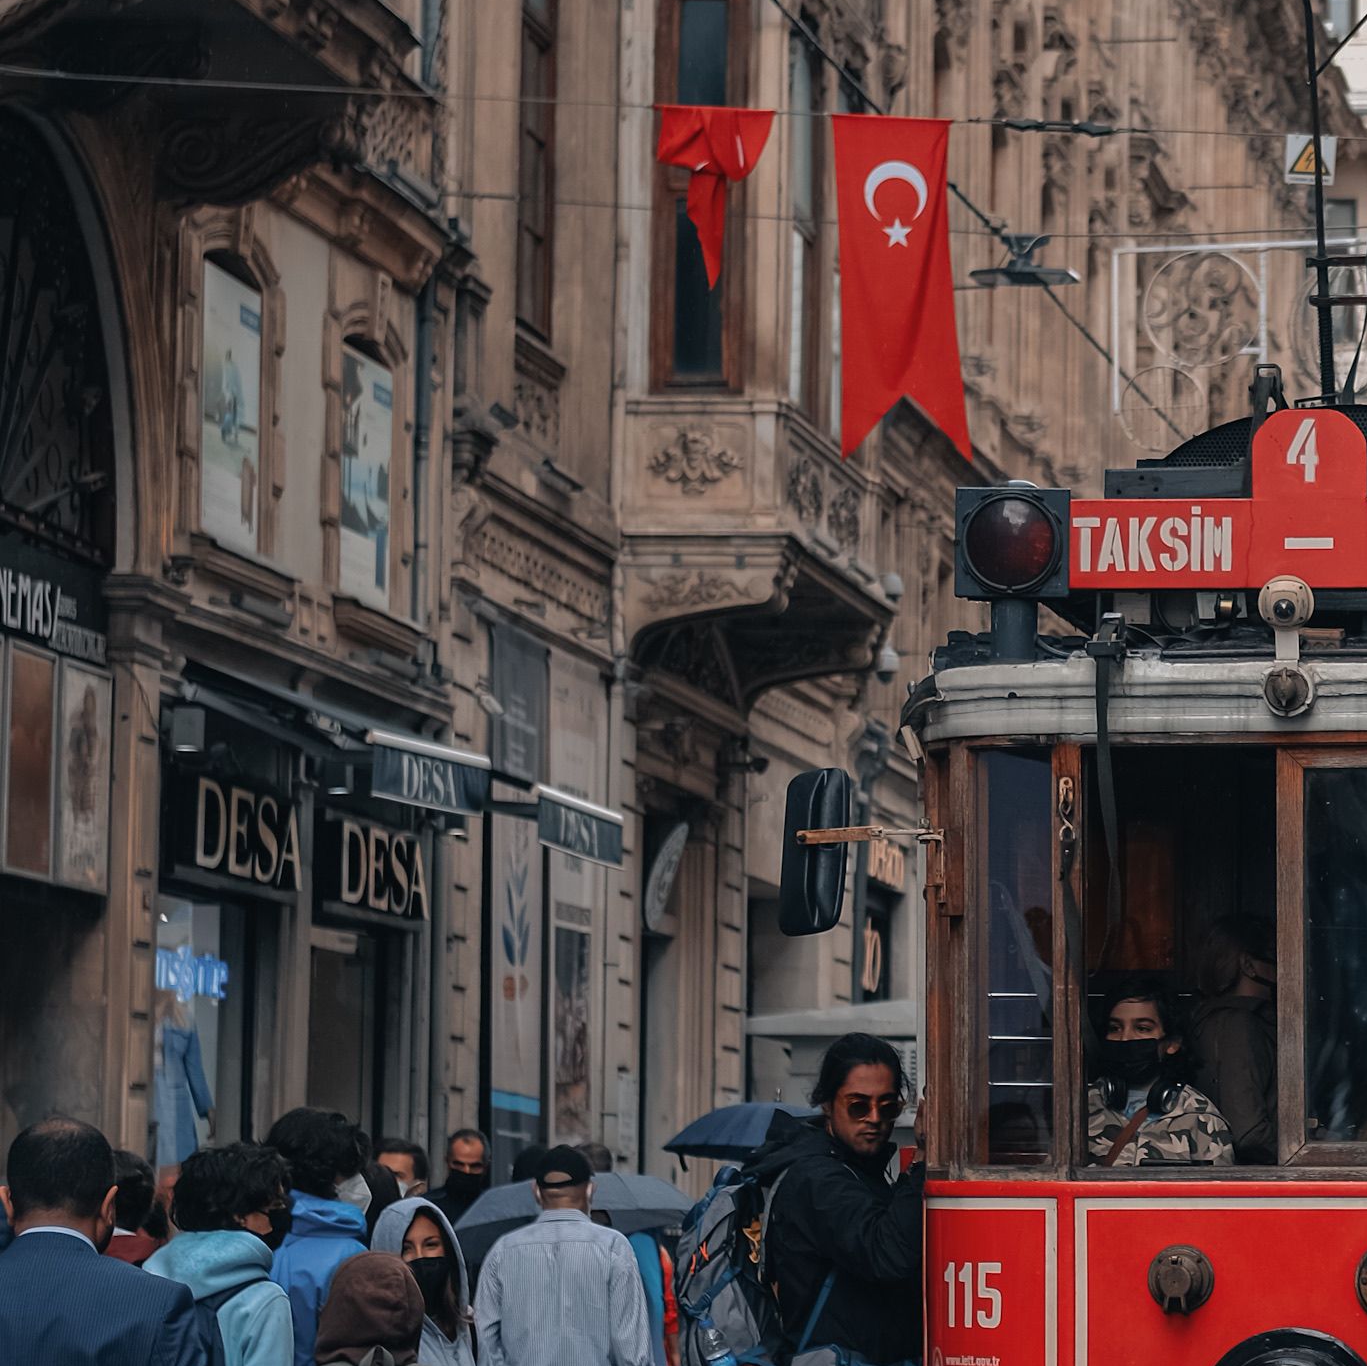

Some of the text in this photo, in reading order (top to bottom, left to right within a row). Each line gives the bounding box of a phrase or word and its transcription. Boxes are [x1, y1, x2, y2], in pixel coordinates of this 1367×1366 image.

[1286, 417, 1319, 483] 4
[1072, 505, 1233, 572] TAKSİM
[401, 754, 457, 808] DESA
[195, 776, 303, 892] DESA
[341, 819, 429, 921] DESA
[943, 1261, 1003, 1330] 115
